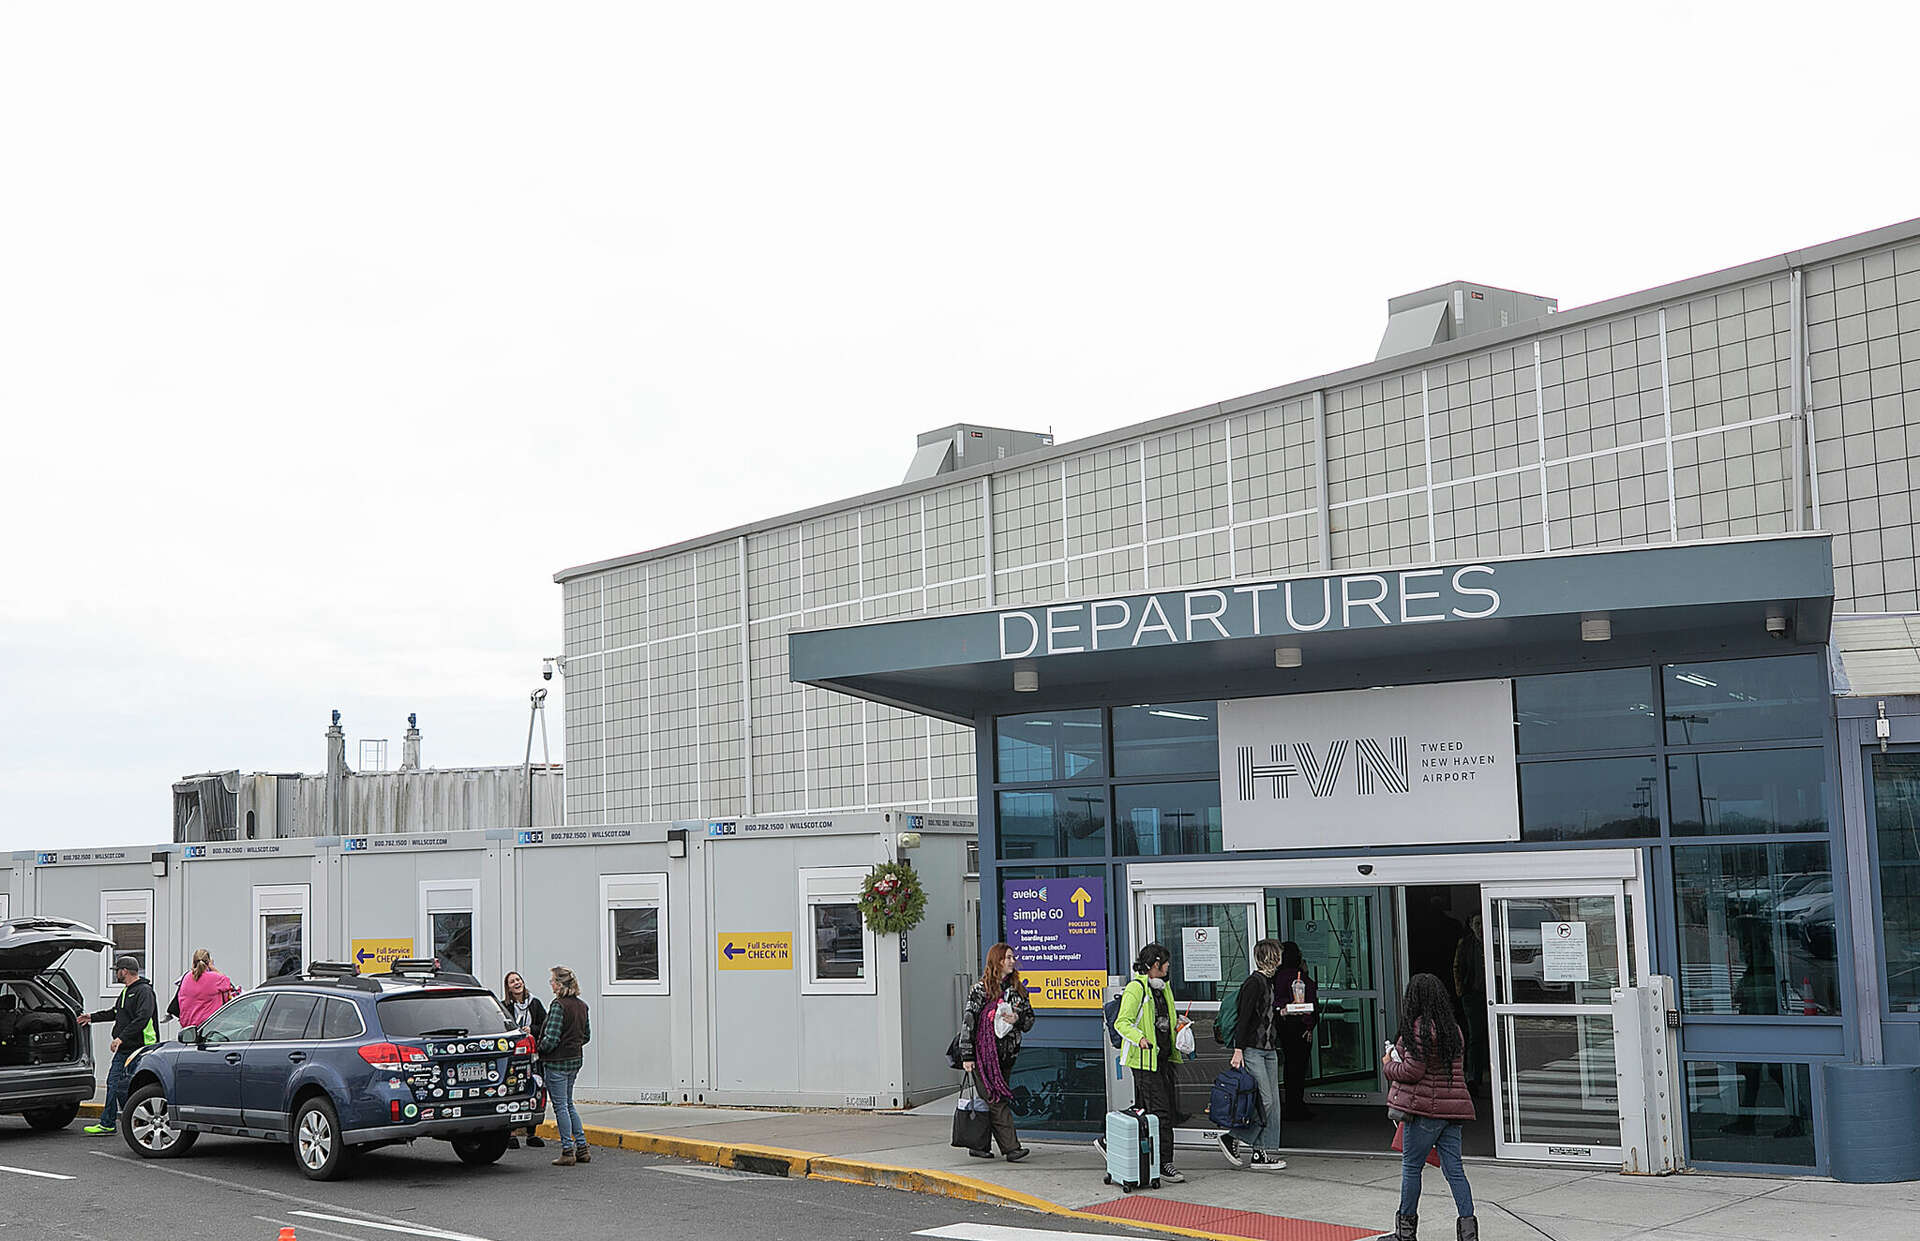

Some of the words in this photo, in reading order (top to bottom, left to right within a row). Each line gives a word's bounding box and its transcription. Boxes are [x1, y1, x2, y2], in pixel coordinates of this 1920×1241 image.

[999, 565, 1501, 661] DEPARTURES
[1420, 741, 1464, 752] TWEED
[1421, 758, 1448, 768] NEW
[1453, 755, 1496, 766] HAVEN
[1237, 736, 1411, 801] HVN
[1422, 771, 1476, 782] AIRPORT
[709, 823, 736, 834] FLEX
[744, 823, 785, 831] 800.782.1500
[789, 821, 833, 829] WILLSCOT.COM
[518, 832, 543, 842] FLEX
[592, 830, 631, 838] WILLSCOT.COM
[1012, 888, 1038, 899] avelo
[1013, 908, 1046, 922] simple
[1048, 908, 1064, 919] GO
[388, 946, 410, 954] Service
[761, 940, 788, 949] Service
[747, 950, 776, 959] CHECK
[778, 950, 788, 958] IN
[1059, 953, 1081, 961] prepaid?
[1045, 977, 1061, 987] Full
[1064, 976, 1100, 987] Service
[1046, 989, 1086, 1000] CHECK
[1088, 989, 1101, 1000] IN
